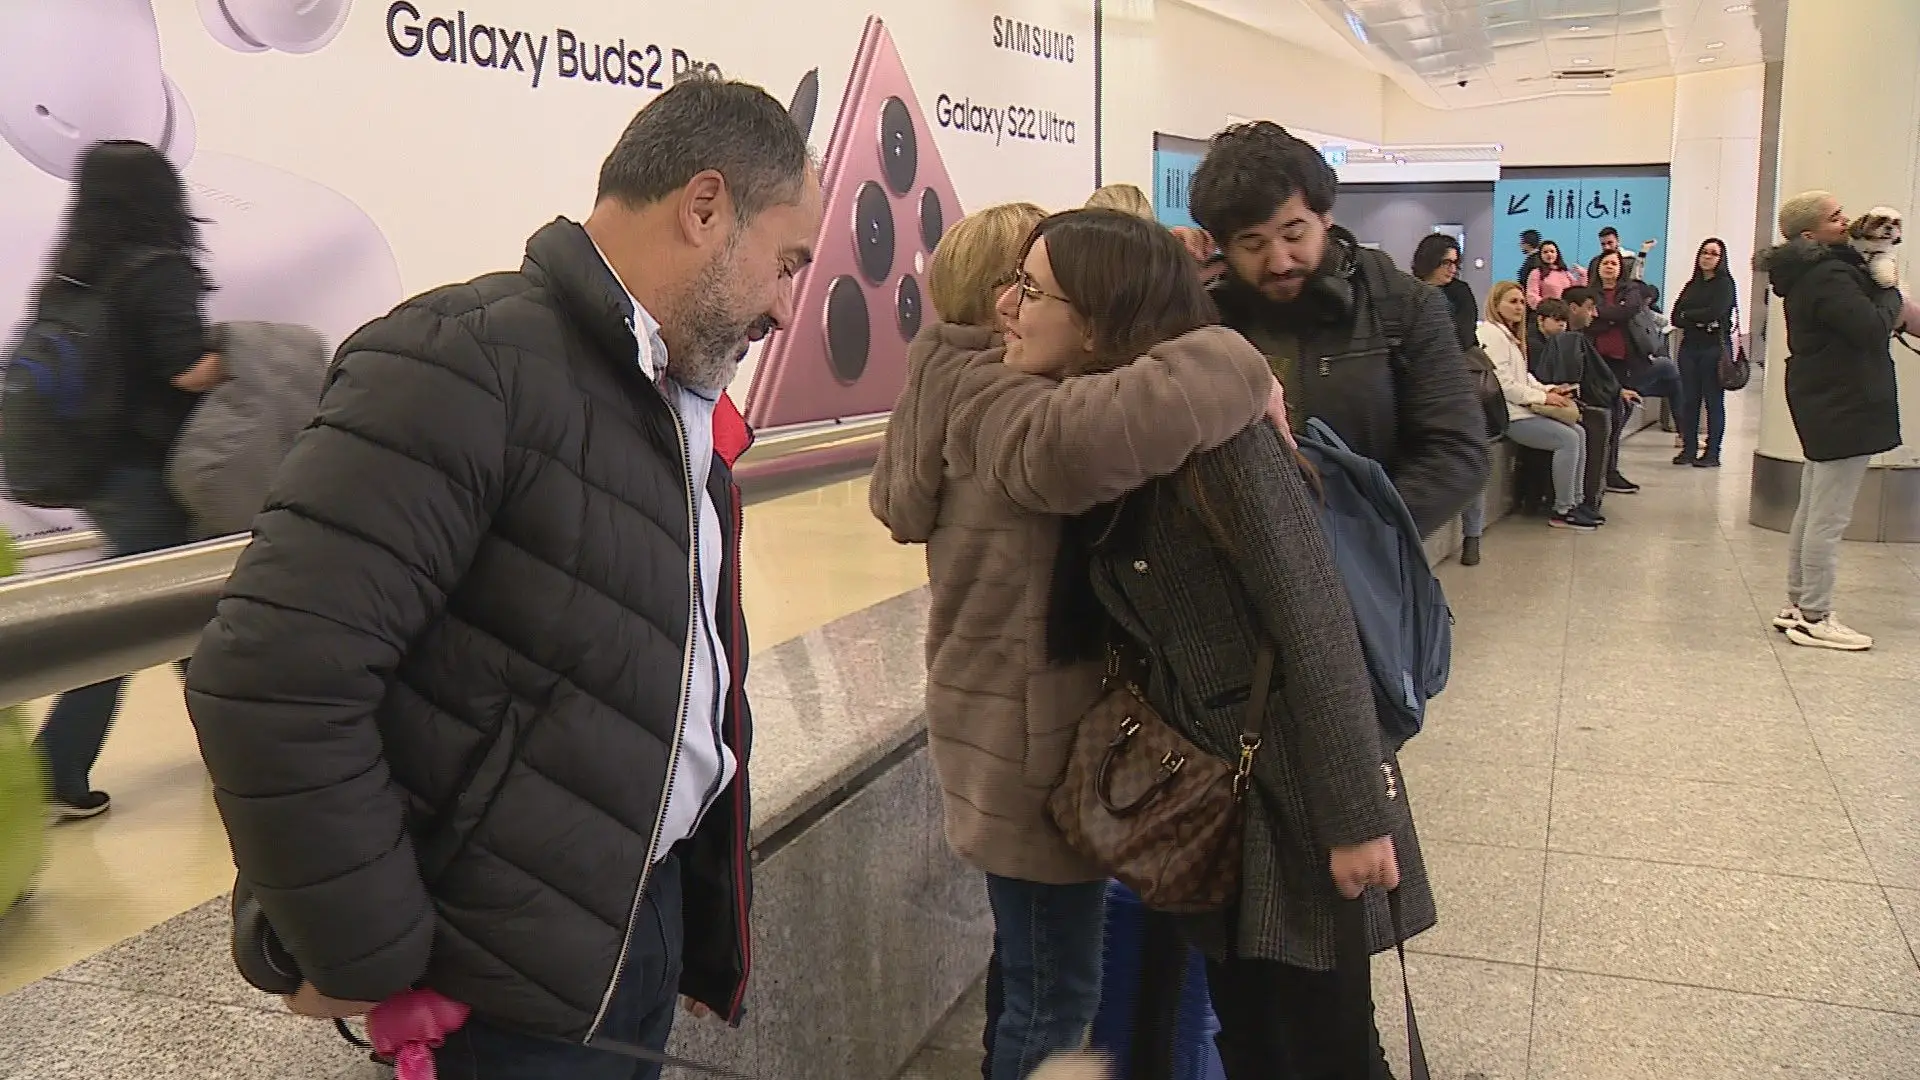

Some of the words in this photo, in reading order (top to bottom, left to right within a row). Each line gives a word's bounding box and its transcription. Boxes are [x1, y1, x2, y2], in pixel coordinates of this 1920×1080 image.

[386, 0, 548, 88] Galaxy
[556, 28, 663, 90] Buds2
[993, 15, 1075, 63] SAMSUNG
[936, 93, 1005, 147] Galaxy
[1007, 105, 1036, 139] S22
[1038, 109, 1076, 144] Ultra
